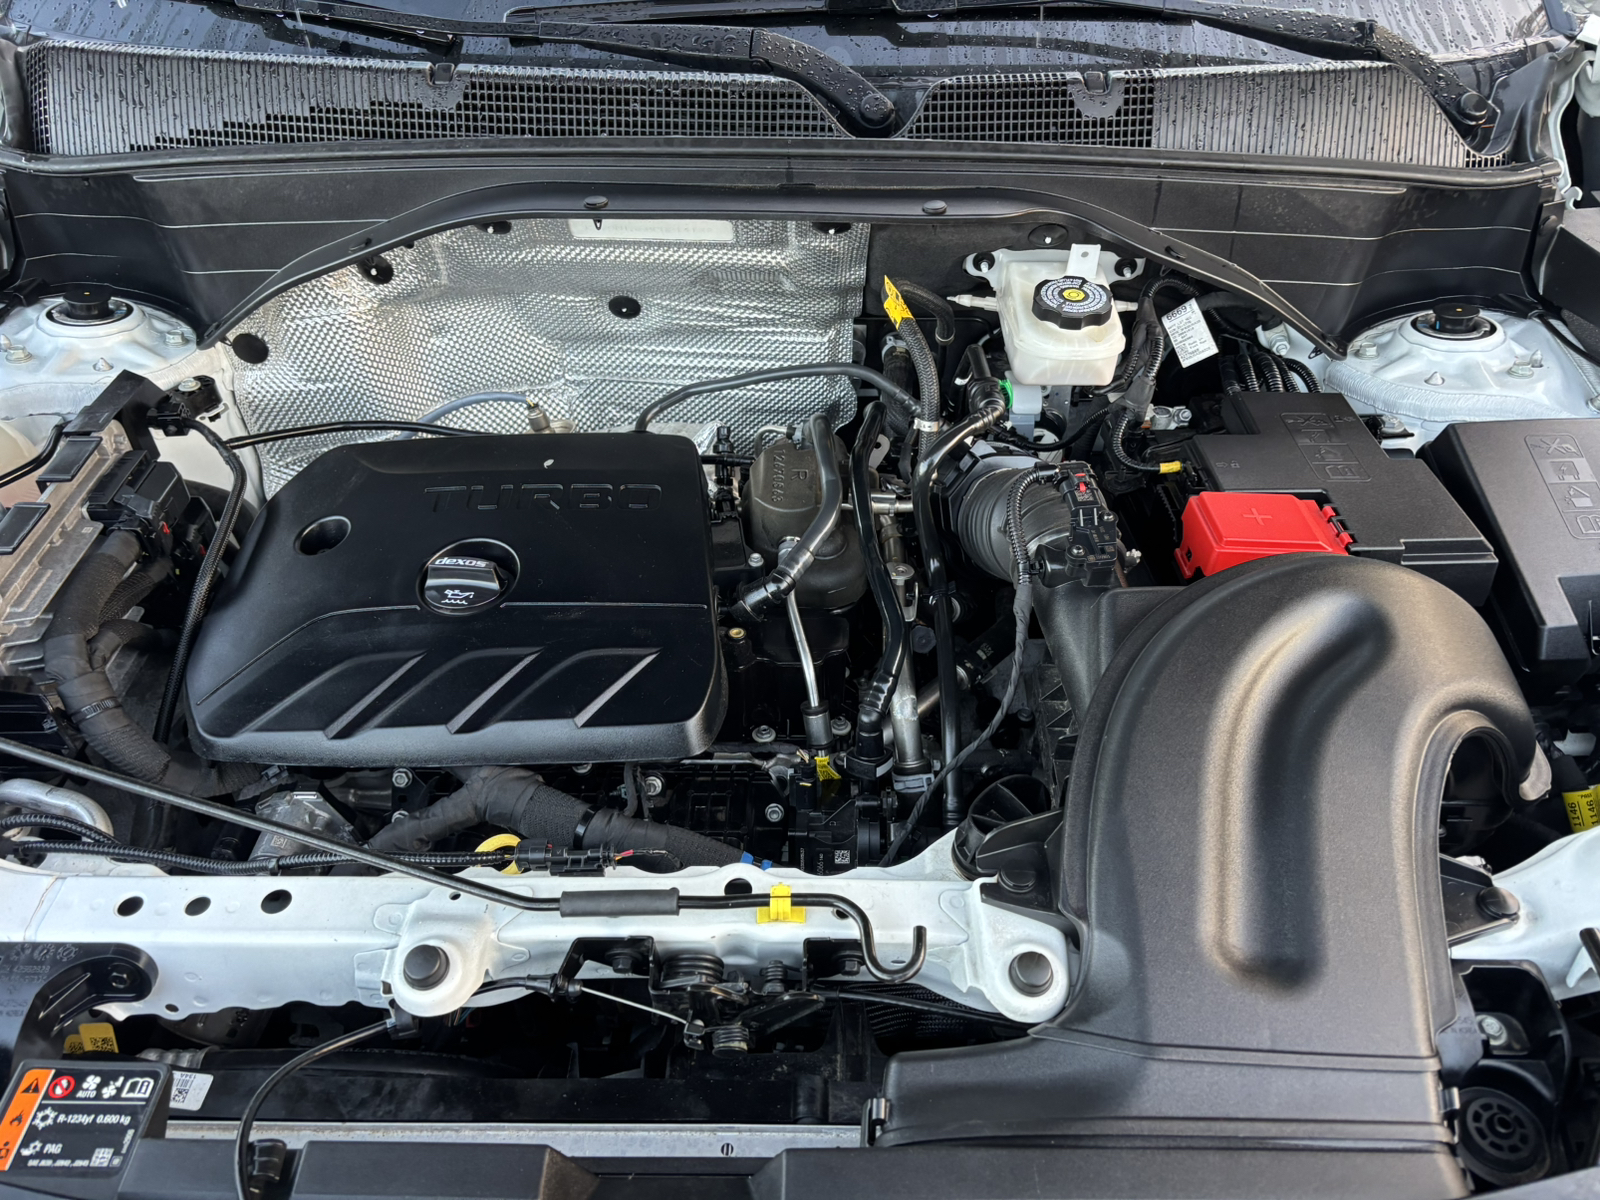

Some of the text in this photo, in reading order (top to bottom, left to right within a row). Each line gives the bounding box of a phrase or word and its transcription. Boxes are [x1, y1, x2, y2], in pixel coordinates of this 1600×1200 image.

[1166, 305, 1188, 321] 6669
[790, 468, 809, 481] R
[423, 483, 663, 512] TURBO
[434, 556, 488, 568] dexos
[1567, 801, 1582, 827] 1146
[1586, 799, 1599, 826] 1146
[76, 1089, 97, 1099] AUTO
[56, 1113, 131, 1126] R-1234yf 0.600 kg
[43, 1143, 63, 1154] PAG
